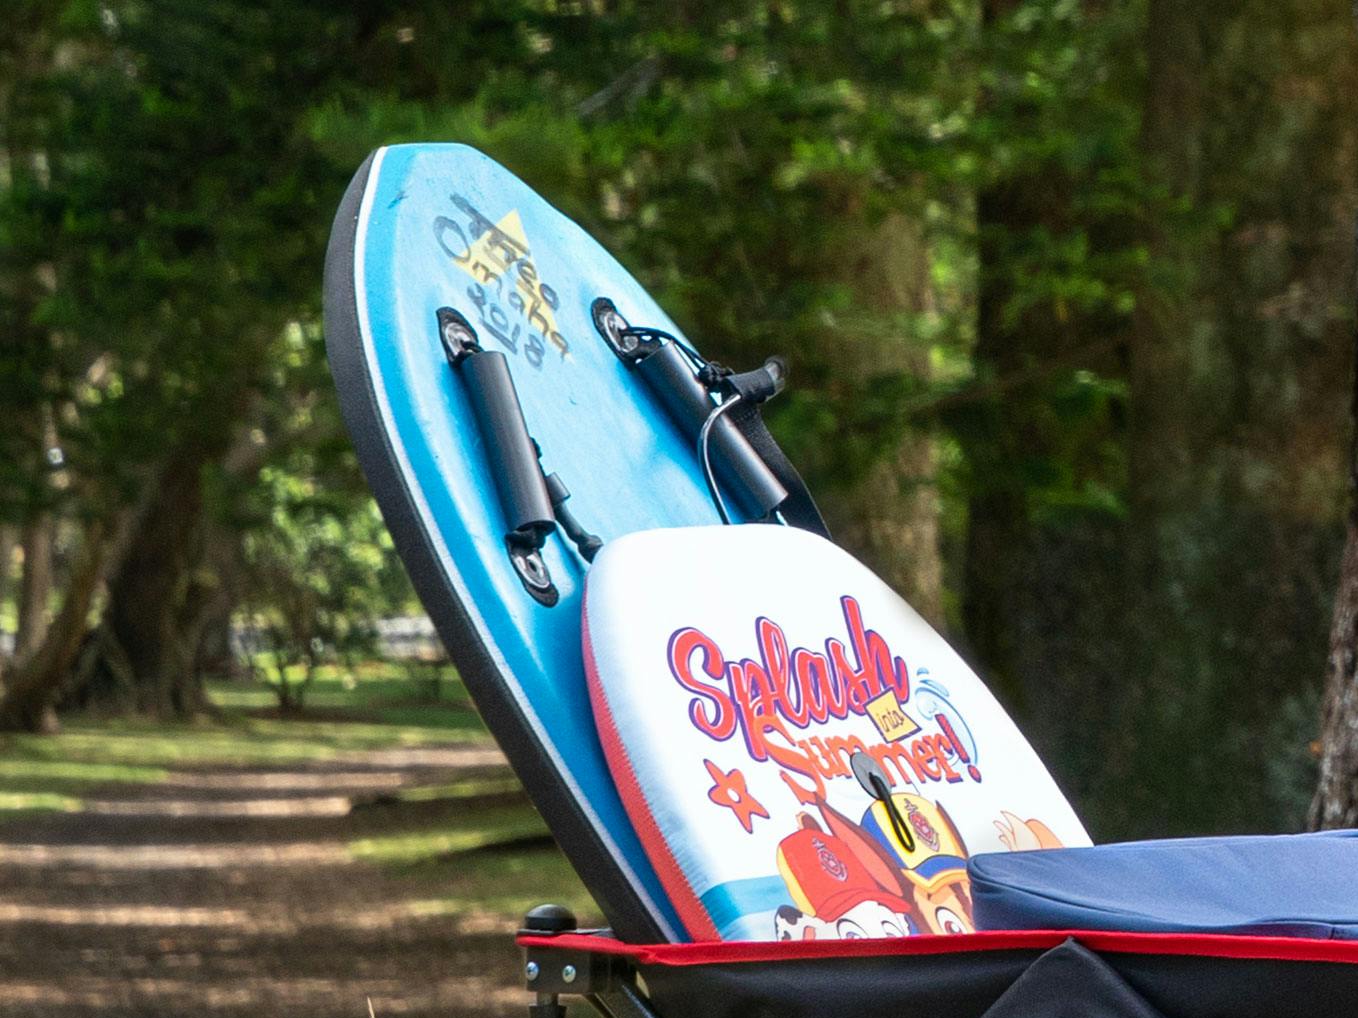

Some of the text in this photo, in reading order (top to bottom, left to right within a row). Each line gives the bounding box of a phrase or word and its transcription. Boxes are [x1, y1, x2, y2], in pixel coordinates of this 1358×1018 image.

[433, 215, 570, 361] Omaha
[466, 282, 545, 368] 2018
[666, 595, 909, 762] Splash
